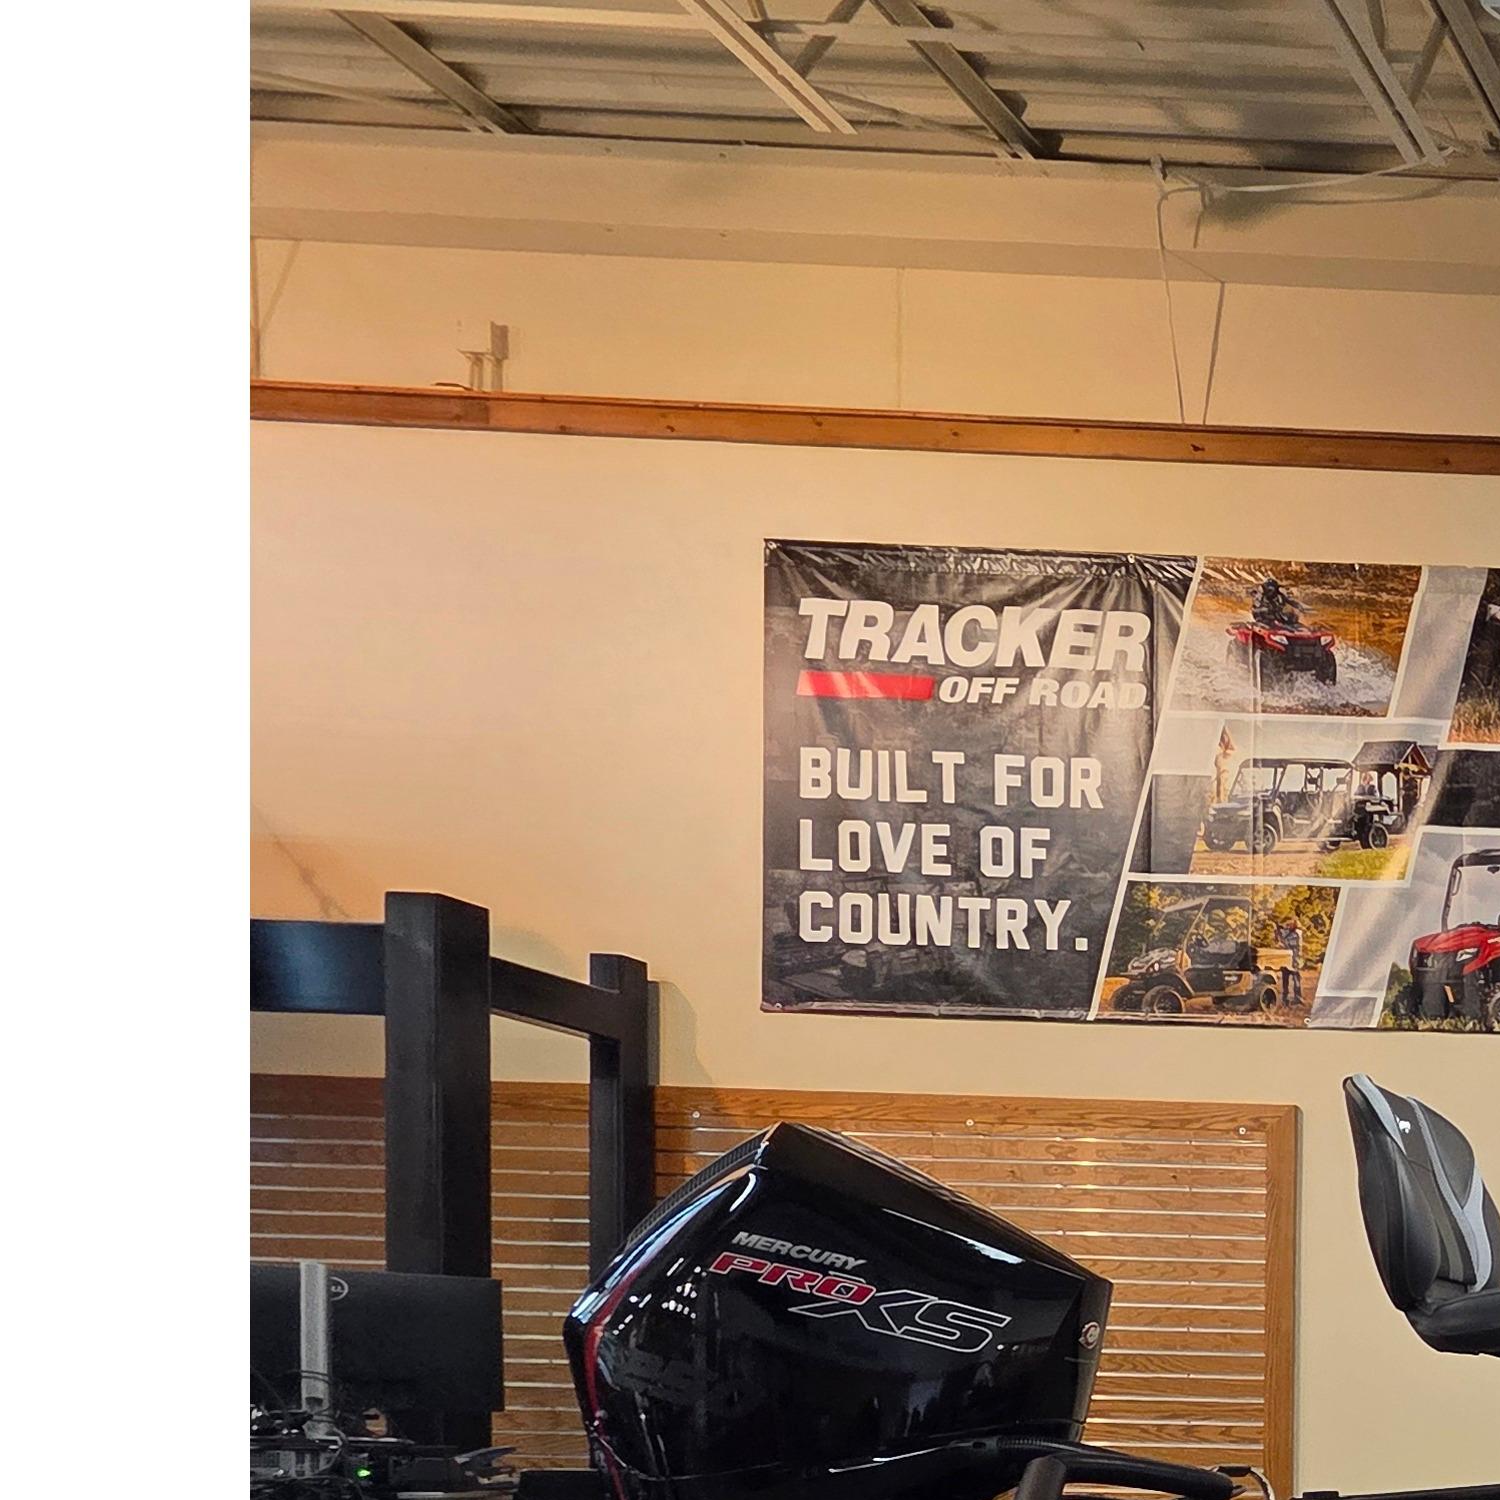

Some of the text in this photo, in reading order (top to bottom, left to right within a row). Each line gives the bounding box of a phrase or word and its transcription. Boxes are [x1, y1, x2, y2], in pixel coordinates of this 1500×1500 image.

[798, 597, 1152, 672] TRACKER
[938, 675, 1148, 711] OFF ROAD
[799, 746, 1104, 809] BUILT FOR
[799, 818, 1052, 880] LOVE OF
[799, 890, 1089, 952] COUNTRY.
[731, 1231, 868, 1271] MERCURY
